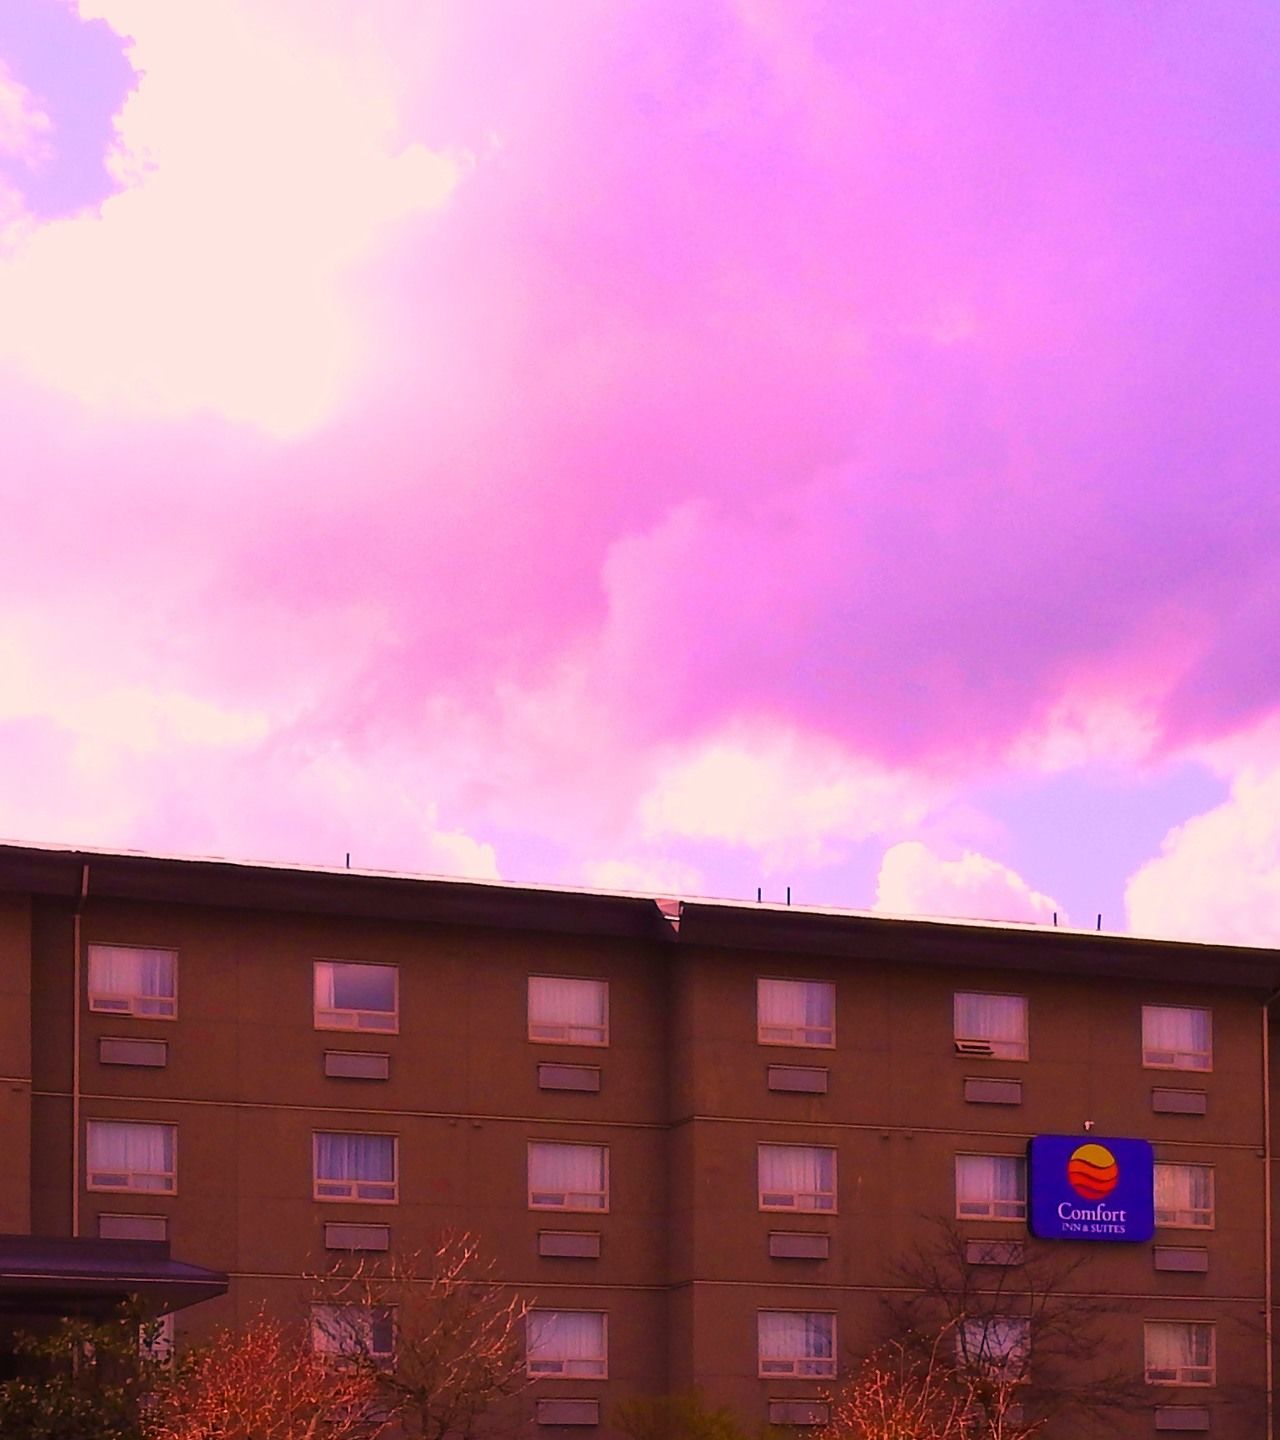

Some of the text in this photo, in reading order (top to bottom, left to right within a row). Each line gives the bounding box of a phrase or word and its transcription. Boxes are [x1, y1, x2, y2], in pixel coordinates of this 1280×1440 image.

[1058, 1202, 1127, 1222] Comfort
[1062, 1223, 1126, 1234] INN & SUITES
